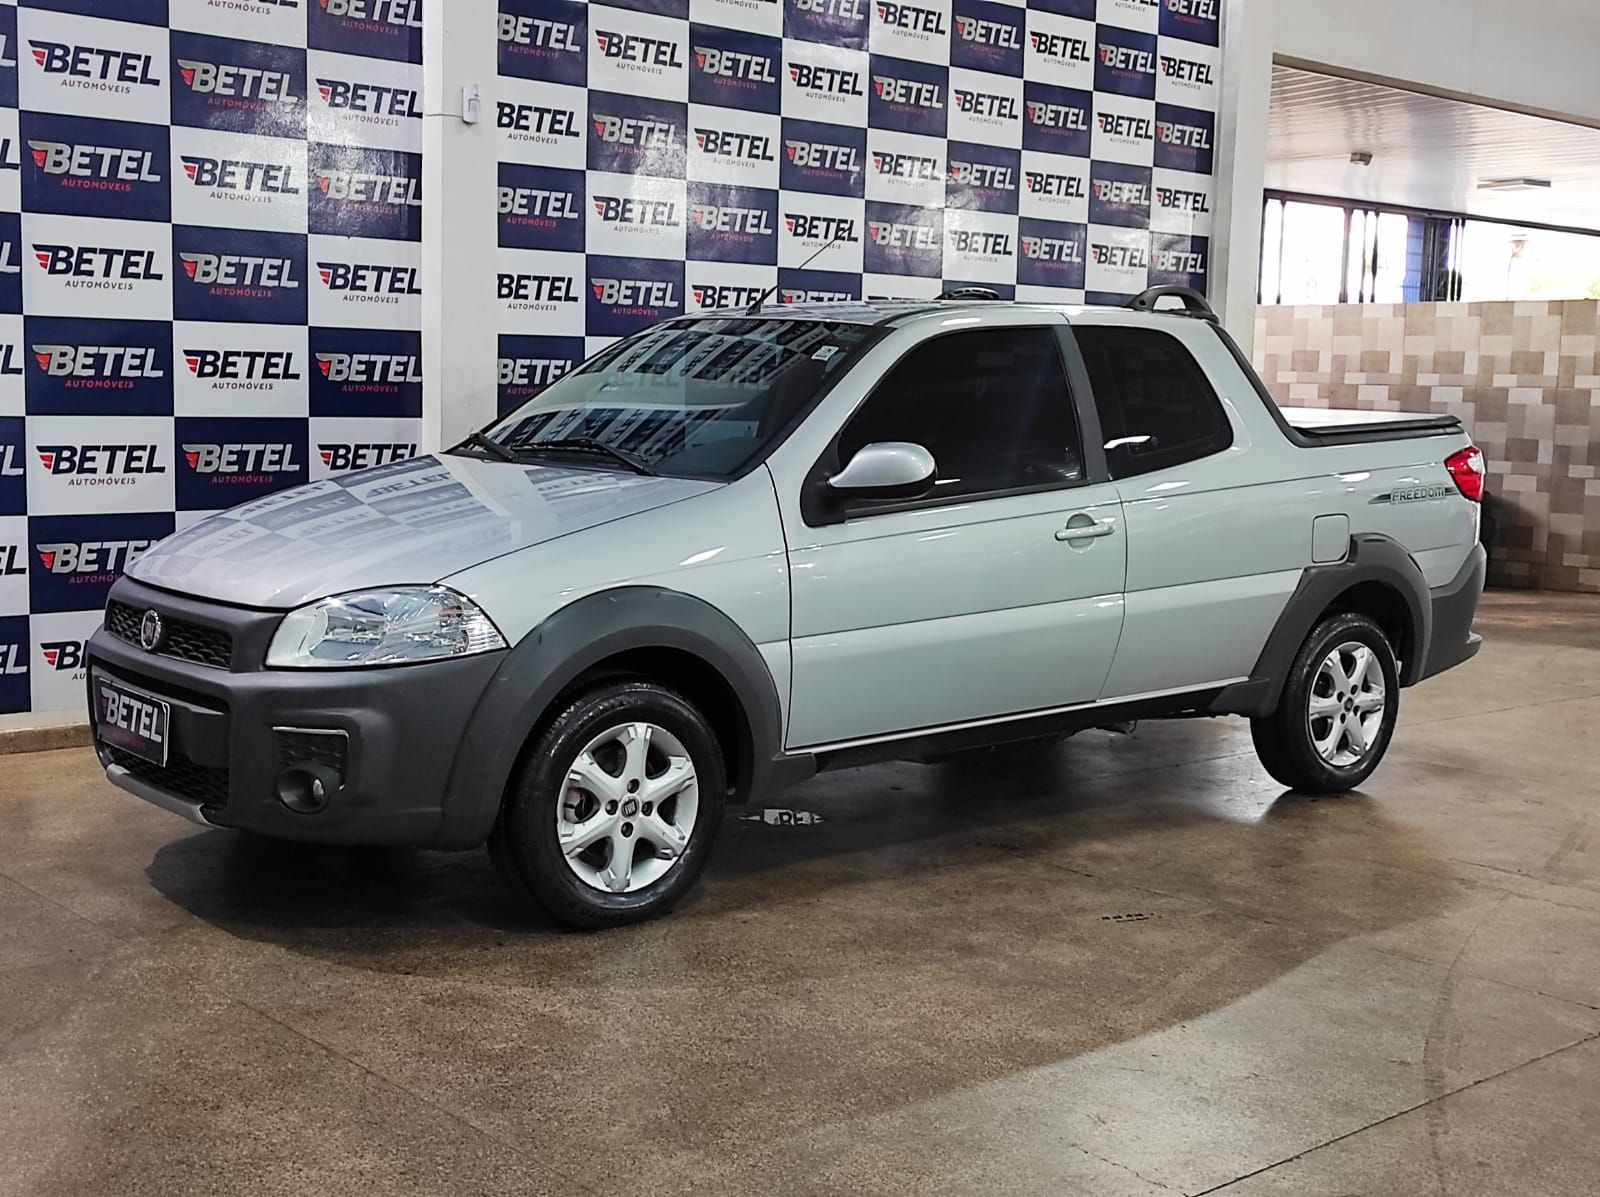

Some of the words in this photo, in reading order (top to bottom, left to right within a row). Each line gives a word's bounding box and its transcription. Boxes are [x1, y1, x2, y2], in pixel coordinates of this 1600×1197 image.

[326, 0, 422, 27] BETEL
[341, 20, 399, 36] AUTOMÓVEIS
[882, 3, 946, 35] BETEL
[499, 14, 581, 53] BETEL
[961, 17, 1021, 50] BETEL
[1034, 33, 1090, 62] BETEL
[44, 44, 161, 86] BETEL
[604, 34, 683, 69] BETEL
[1105, 45, 1155, 74] BETEL
[702, 49, 776, 84] BETEL
[797, 63, 863, 96] BETEL
[1164, 57, 1213, 85] BETEL
[61, 79, 131, 93] AUTOMÓVEIS
[191, 63, 298, 102] BETEL
[880, 79, 943, 110] BETEL
[328, 82, 422, 119] BETEL
[959, 91, 1018, 120] BETEL
[342, 114, 399, 127] AUTOMÓVEIS
[497, 101, 580, 137] BETEL
[1032, 103, 1088, 131] BETEL
[1101, 113, 1153, 140] BETEL
[602, 118, 681, 150] BETEL
[701, 130, 774, 162] BETEL
[1162, 124, 1210, 150] BETEL
[44, 142, 161, 183] BETEL
[791, 143, 861, 173] BETEL
[879, 152, 941, 181] BETEL
[61, 178, 131, 192] AUTOMÓVEIS
[195, 158, 299, 195] BETEL
[327, 170, 422, 206] BETEL
[957, 162, 1015, 190] BETEL
[1030, 172, 1084, 199] BETEL
[210, 191, 272, 204] AUTOMÓVEIS
[498, 187, 579, 219] BETEL
[1099, 180, 1150, 206] BETEL
[1160, 189, 1209, 213] BETEL
[600, 198, 680, 227] BETEL
[699, 206, 772, 235] BETEL
[792, 214, 859, 243] BETEL
[876, 222, 938, 247] BETEL
[954, 231, 1012, 256] BETEL
[1029, 239, 1082, 263] BETEL
[1096, 244, 1147, 269] BETEL
[46, 246, 163, 281] BETEL
[193, 255, 299, 288] BETEL
[1156, 250, 1205, 274] BETEL
[65, 280, 134, 291] AUTOMÓVEIS
[209, 287, 272, 298] AUTOMÓVEIS
[329, 264, 422, 295] BETEL
[497, 273, 578, 302] BETEL
[599, 280, 679, 308] BETEL
[342, 294, 399, 304] AUTOMÓVEIS
[45, 347, 164, 379] BETEL
[196, 351, 300, 380] BETEL
[326, 353, 422, 383] BETEL
[65, 379, 134, 388] AUTOMÓVEIS
[211, 382, 274, 390] AUTOMÓVEIS
[342, 384, 398, 392] AUTOMÓVEIS
[50, 445, 166, 475] BETEL
[195, 443, 300, 472] BETEL
[68, 477, 136, 486] AUTOMÓVEIS
[211, 475, 273, 484] AUTOMÓVEIS
[1391, 486, 1444, 502] FREEDOM
[105, 688, 162, 744] BETEL
